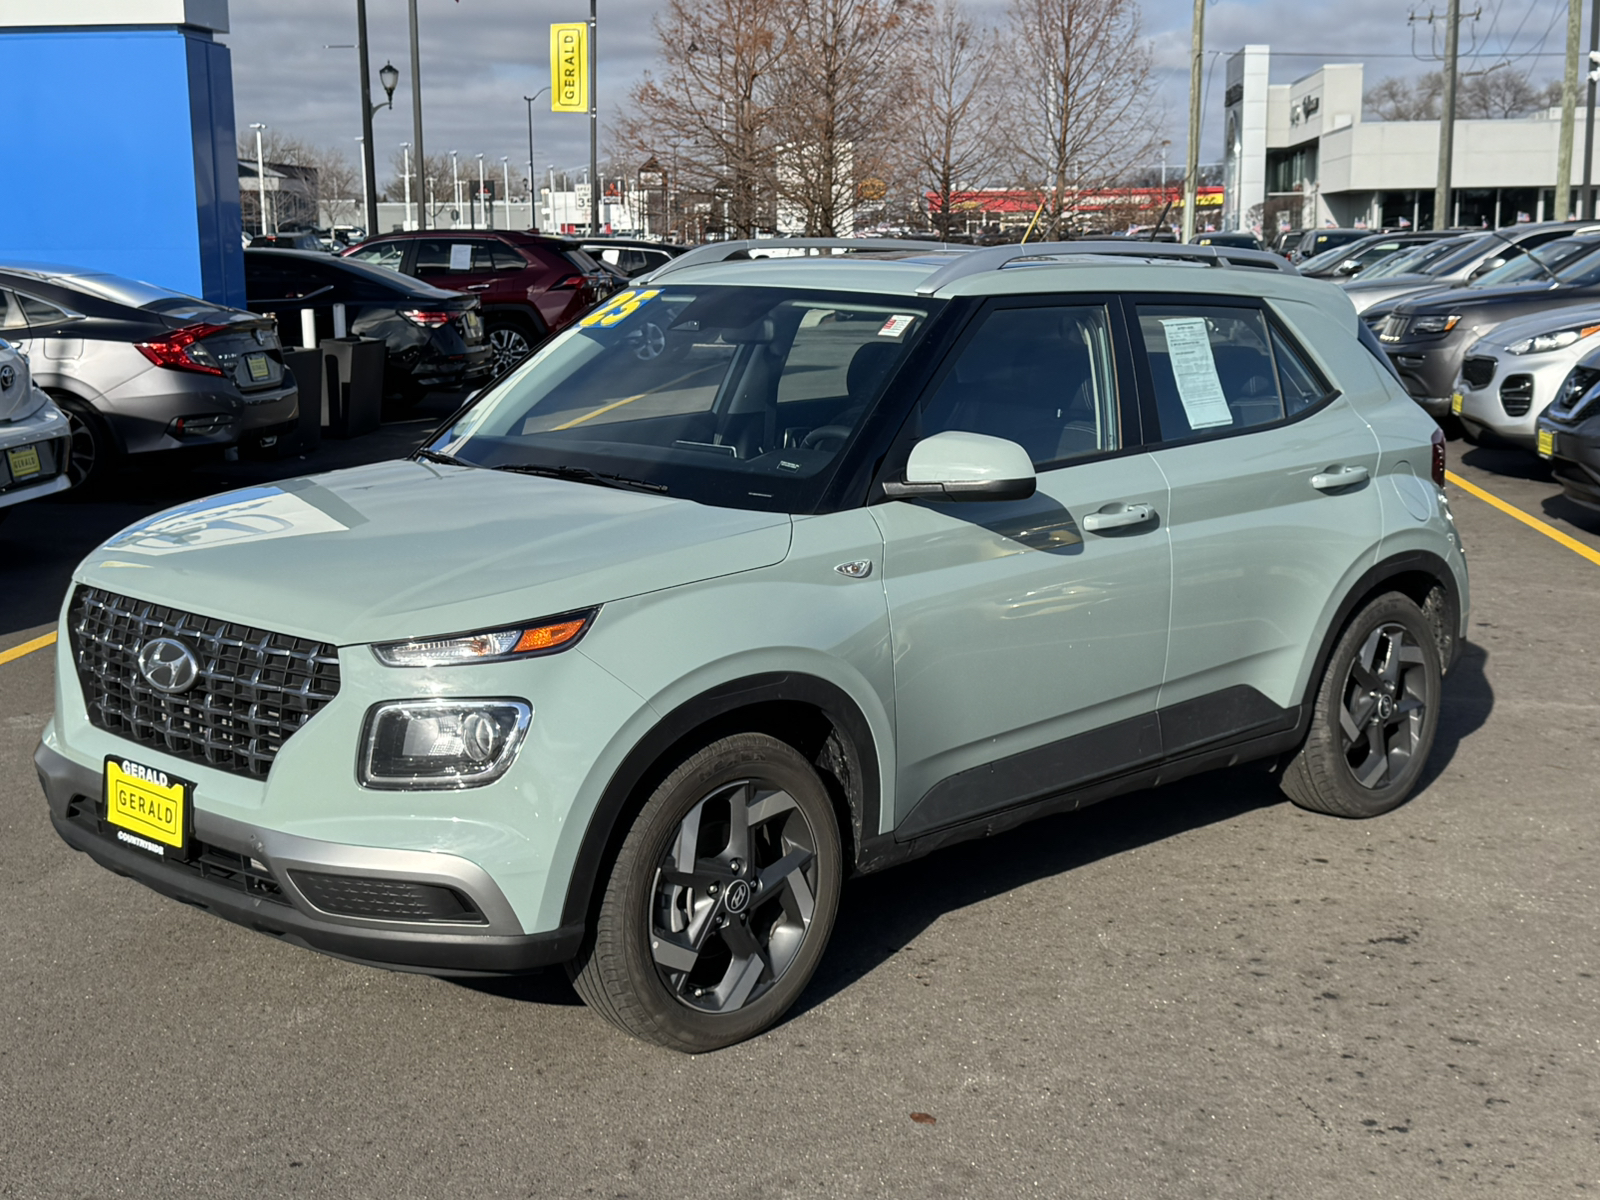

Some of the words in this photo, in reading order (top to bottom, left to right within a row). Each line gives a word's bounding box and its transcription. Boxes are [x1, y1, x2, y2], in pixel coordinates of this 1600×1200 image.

[564, 35, 575, 100] GERALD
[579, 290, 660, 327] 25
[122, 760, 168, 787] GERALD
[119, 790, 173, 824] GERALD
